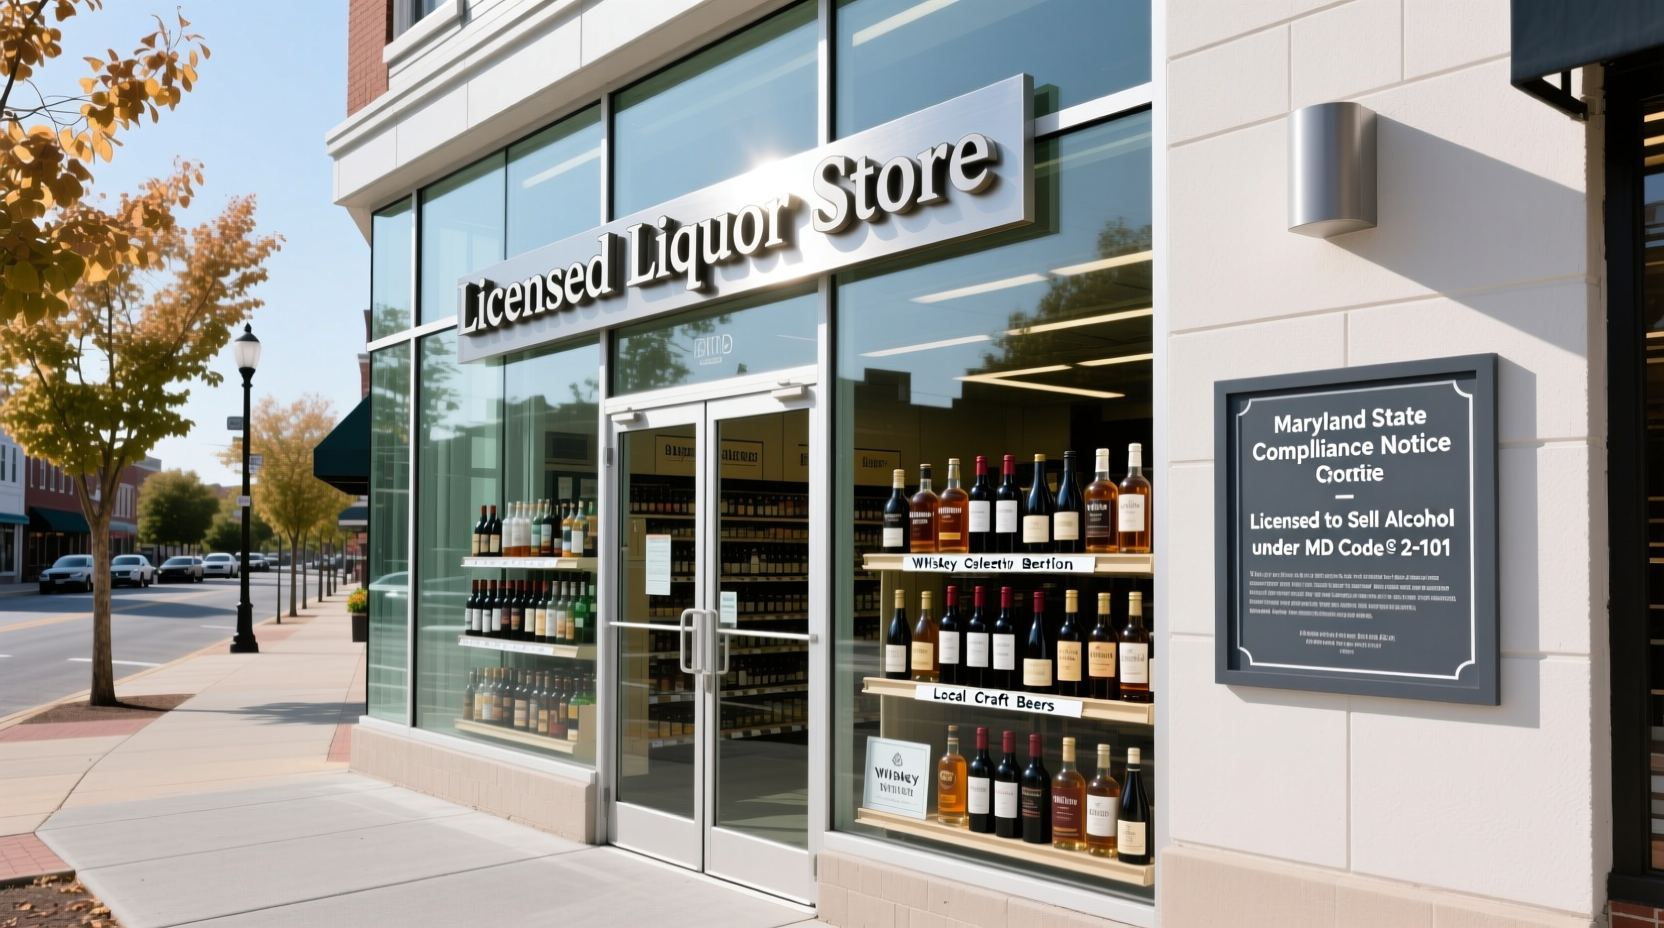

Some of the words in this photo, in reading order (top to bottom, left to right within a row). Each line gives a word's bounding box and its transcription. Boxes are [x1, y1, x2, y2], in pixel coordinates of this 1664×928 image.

[458, 232, 624, 337] Licensed
[626, 193, 797, 292] Liquor
[812, 132, 999, 234] Store
[1274, 408, 1366, 437] Maryland
[1372, 406, 1427, 428] State
[1381, 432, 1452, 455] Notice
[1250, 511, 1320, 530] Licensed
[1324, 512, 1343, 529] to
[1347, 510, 1379, 529] Sell
[1384, 507, 1455, 528] Alcohol
[1252, 538, 1300, 556] under
[1305, 539, 1334, 556] MD
[1400, 538, 1450, 557] 2-101
[934, 688, 966, 702] Local
[975, 691, 1009, 707] Craft
[1017, 696, 1055, 712] Beers
